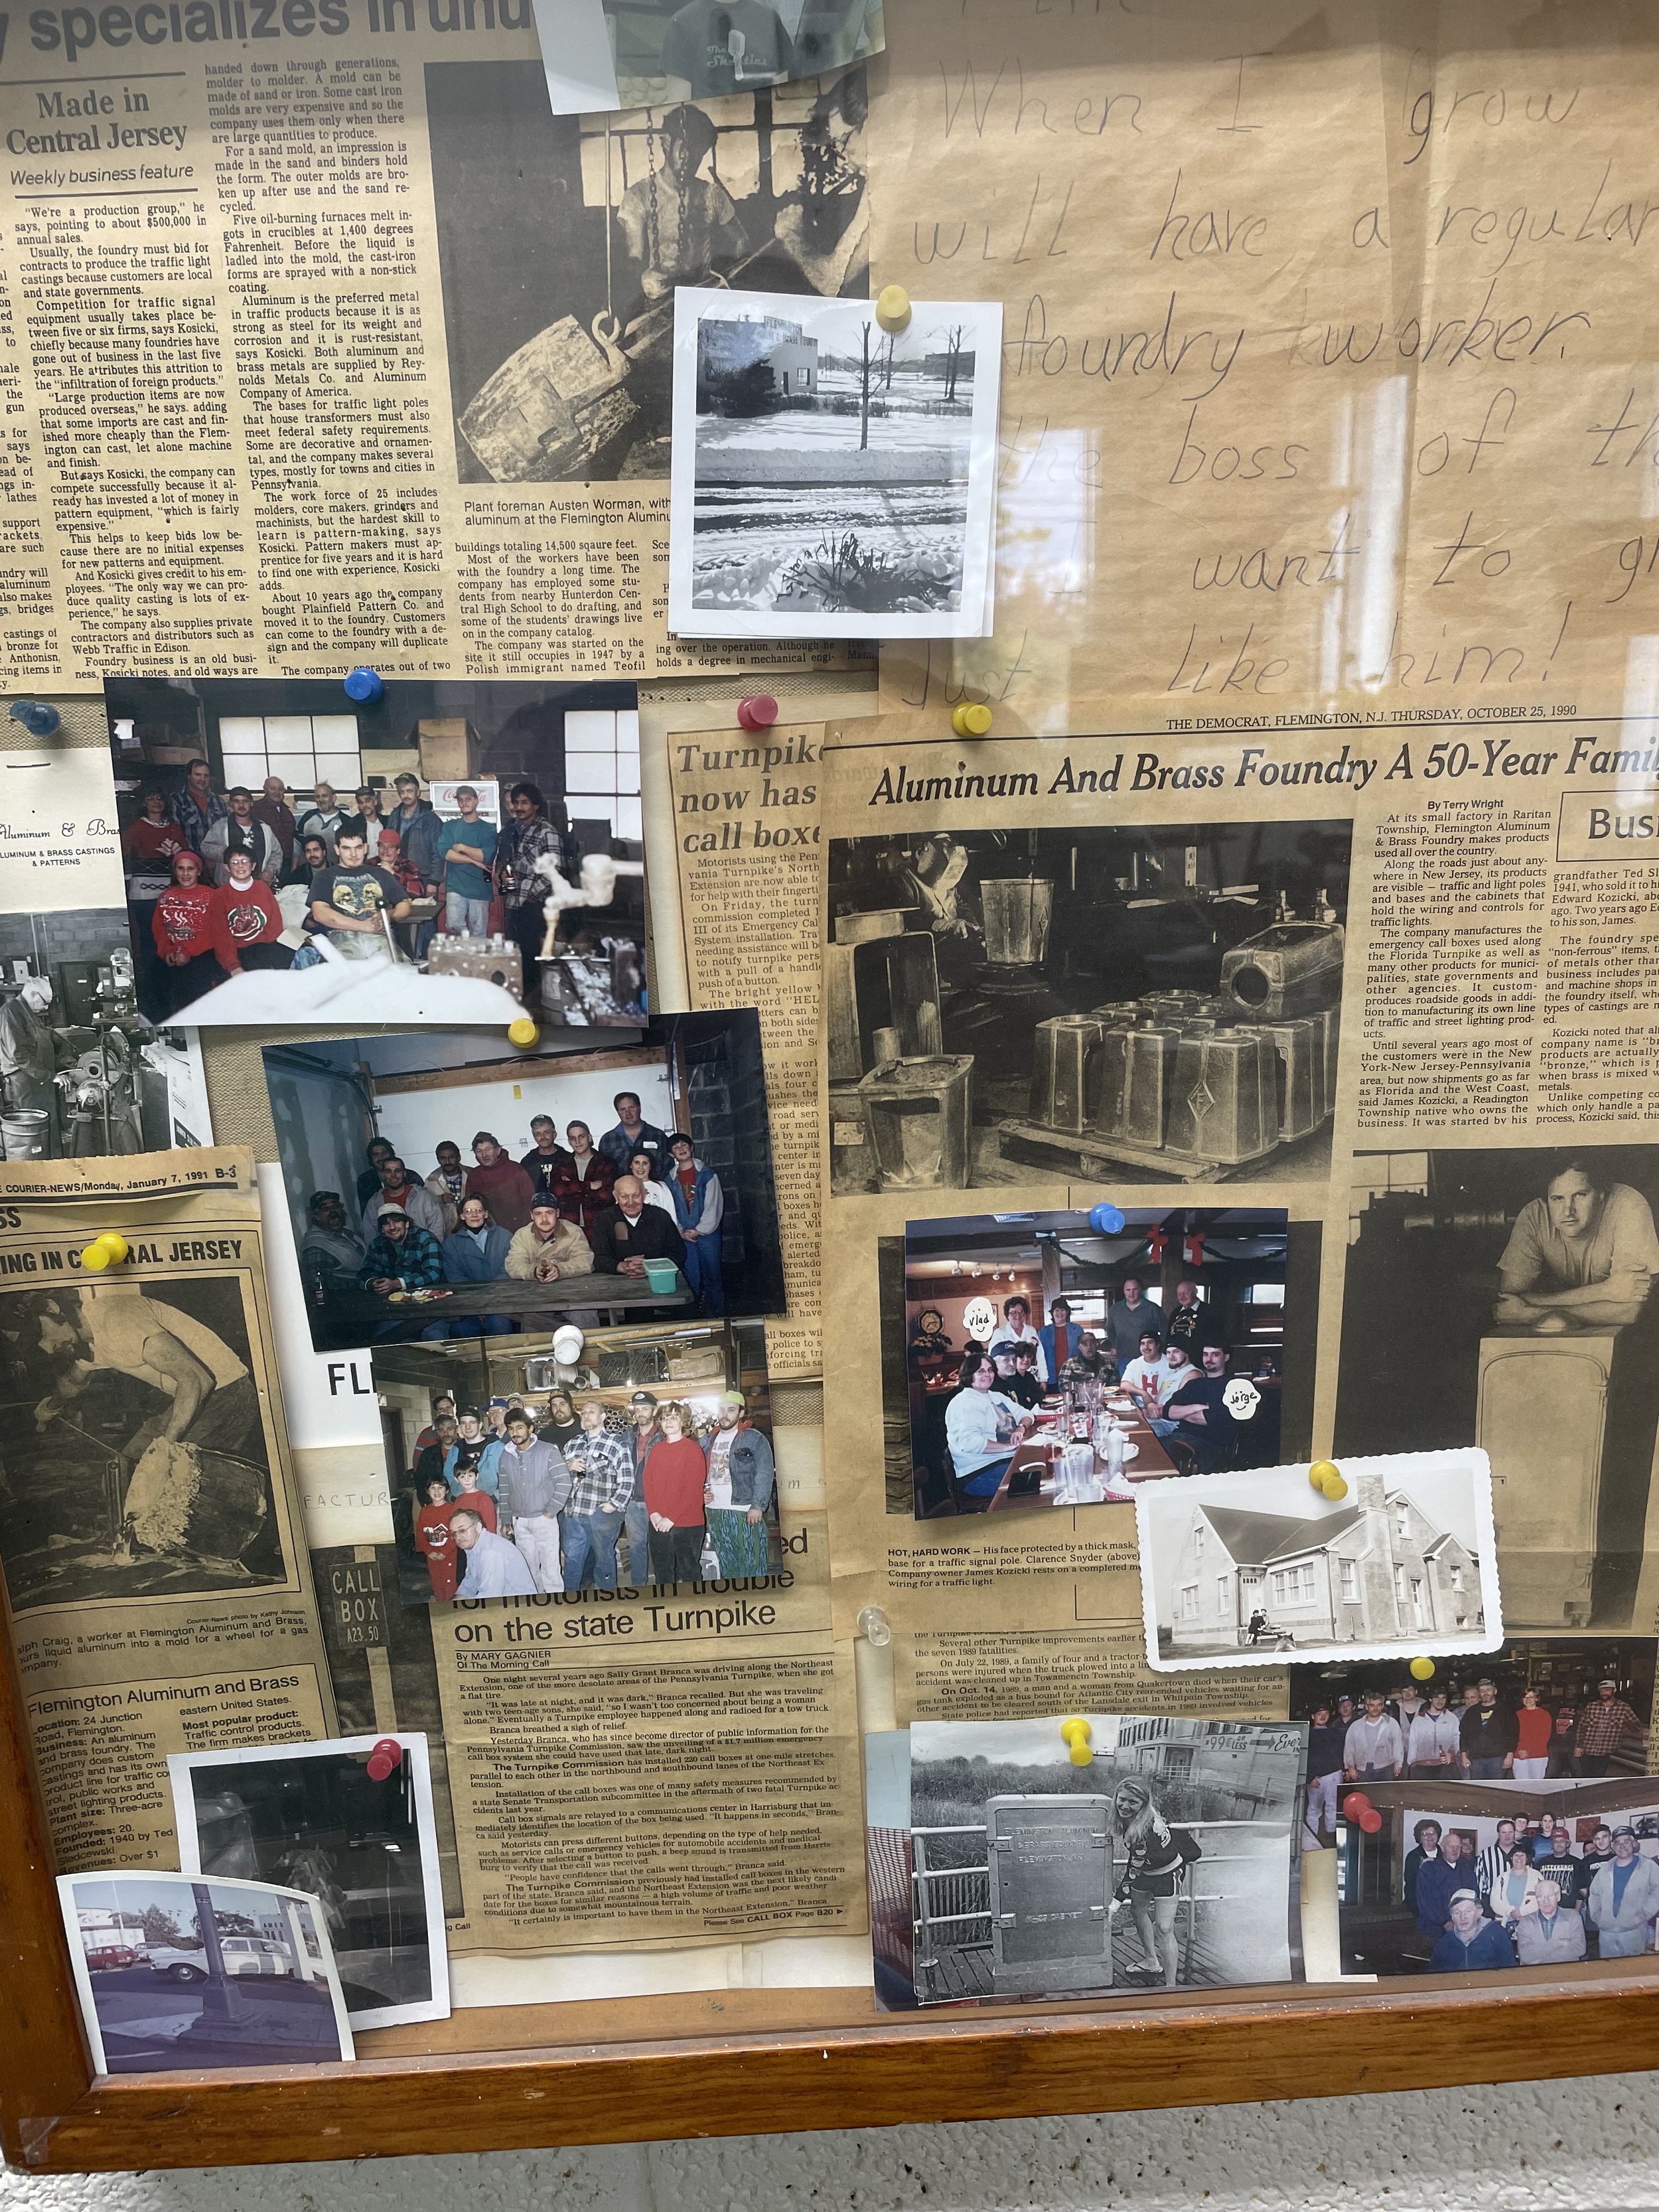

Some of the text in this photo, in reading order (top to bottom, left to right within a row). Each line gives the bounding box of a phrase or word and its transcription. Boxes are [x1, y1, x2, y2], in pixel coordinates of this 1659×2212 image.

[30, 0, 350, 62] specializes
[368, 0, 415, 32] in
[36, 86, 150, 119] Made in
[940, 53, 1580, 165] When I grow
[5, 121, 188, 155] Central Jersey
[10, 163, 194, 188] Weekly business feature
[83, 204, 140, 219] production
[192, 201, 205, 212] he
[1150, 168, 1270, 261] have
[1352, 206, 1390, 250] a
[1003, 293, 1245, 401] foundry
[1169, 404, 1310, 485] boss
[1417, 387, 1517, 476] of
[464, 501, 494, 512] Plant
[496, 500, 545, 512] foreman
[549, 499, 589, 511] Austen
[592, 498, 645, 510] Worman,
[465, 514, 520, 526] aluminum
[524, 514, 536, 525] at
[538, 513, 557, 525] the
[560, 512, 624, 526] Flemington
[1193, 512, 1361, 592] want
[1433, 510, 1511, 586] to
[1379, 601, 1572, 688] him!
[1165, 704, 1577, 730] THE DEMOCRAT, FLEMINGTON, N.J. THURSDAY, OCTOBER 25, 1990
[868, 765, 1039, 806] Aluminum
[1046, 754, 1124, 794] And
[1129, 753, 1225, 791] Brass
[1234, 744, 1378, 790] Foundry
[1384, 742, 1413, 780] A
[1423, 739, 1558, 778] 50-Year
[678, 778, 817, 814] now has
[1427, 799, 1504, 812] By Terry Wright
[1386, 810, 1551, 823] At its small factory in Raritan
[62, 823, 75, 837] &
[683, 821, 743, 853] call
[126, 1178, 167, 1190] January
[171, 1174, 181, 1183] 7,
[184, 1171, 208, 1181] 1991
[216, 1164, 237, 1179] B-3
[0, 1240, 242, 1274] ING IN CRAL JERSEY
[888, 1547, 971, 1558] HOT, HARD WORK
[332, 1568, 380, 1594] CALL
[888, 1580, 918, 1589] wiring
[972, 1578, 993, 1587] light.
[340, 1598, 378, 1623] BOX
[455, 1599, 776, 1643] on the state Turnpike
[42, 1636, 73, 1648] Craig,
[86, 1631, 123, 1643] worker
[127, 1630, 137, 1639] at
[139, 1627, 195, 1639] Flemington
[198, 1622, 249, 1633] Aluminum
[252, 1619, 271, 1629] and
[275, 1616, 307, 1626] Brass,
[456, 1650, 551, 1662] By MARY GAGNIER
[457, 1659, 549, 1670] Of The Morning Call
[27, 1676, 299, 1719] Flemington Aluminum and Brass
[33, 1712, 143, 1735] ocation: 24 Junction
[182, 1710, 301, 1732] Most popular product:
[1232, 1740, 1248, 1750] LESS
[747, 1913, 770, 1923] CALL
[772, 1911, 793, 1919] BOX
